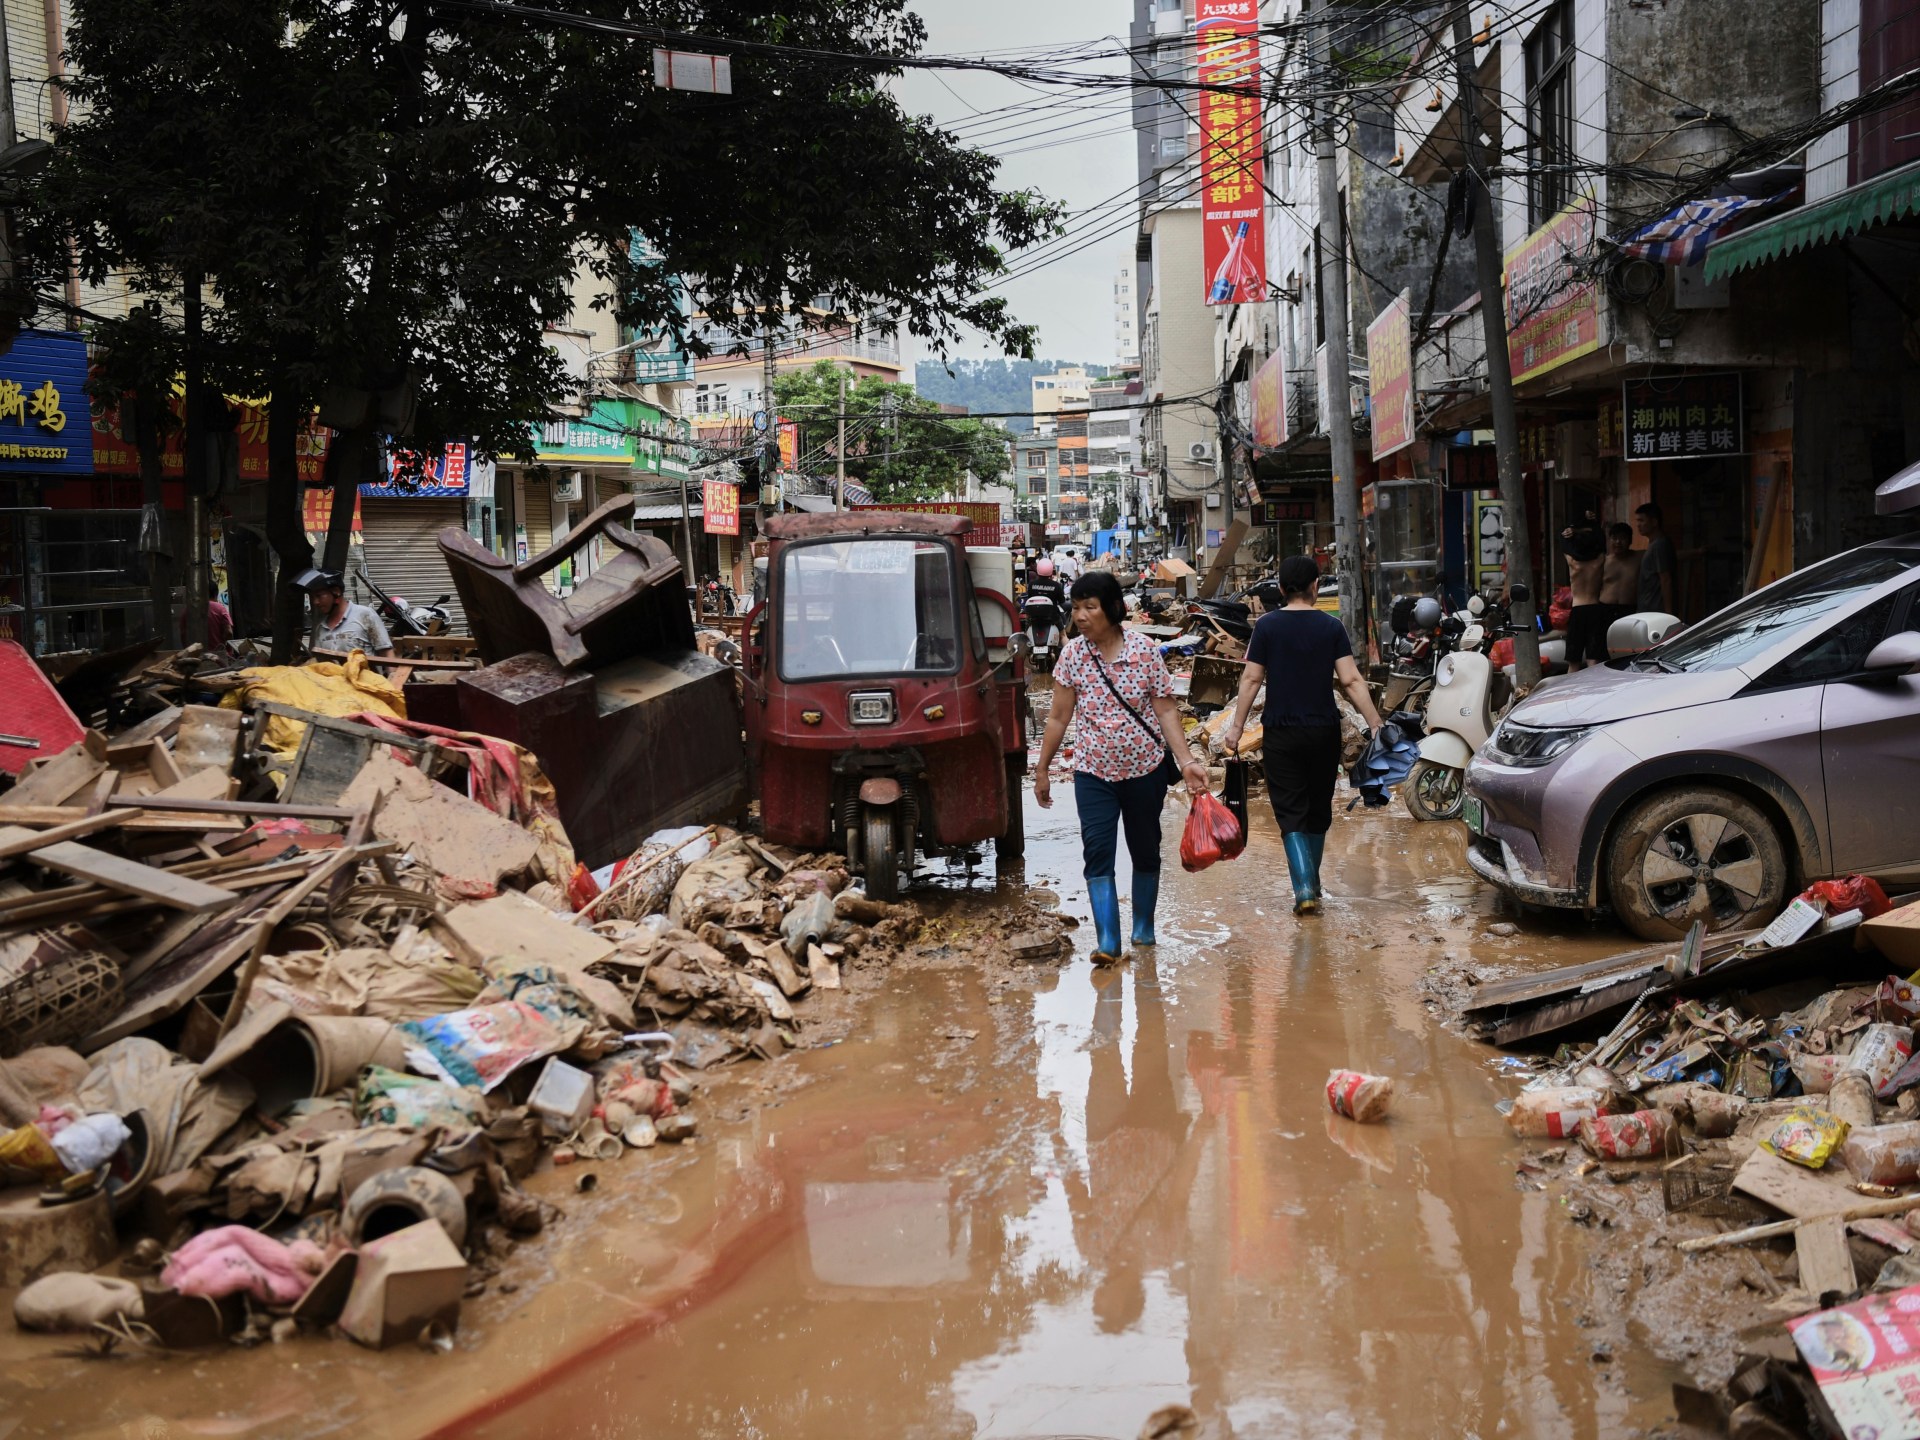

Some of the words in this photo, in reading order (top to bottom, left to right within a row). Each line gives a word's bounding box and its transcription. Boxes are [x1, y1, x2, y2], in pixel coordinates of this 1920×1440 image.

[1632, 403, 1734, 429] 潮州肉丸
[1632, 427, 1734, 454] 新鲜美味
[706, 483, 738, 515] 优乐生鲜
